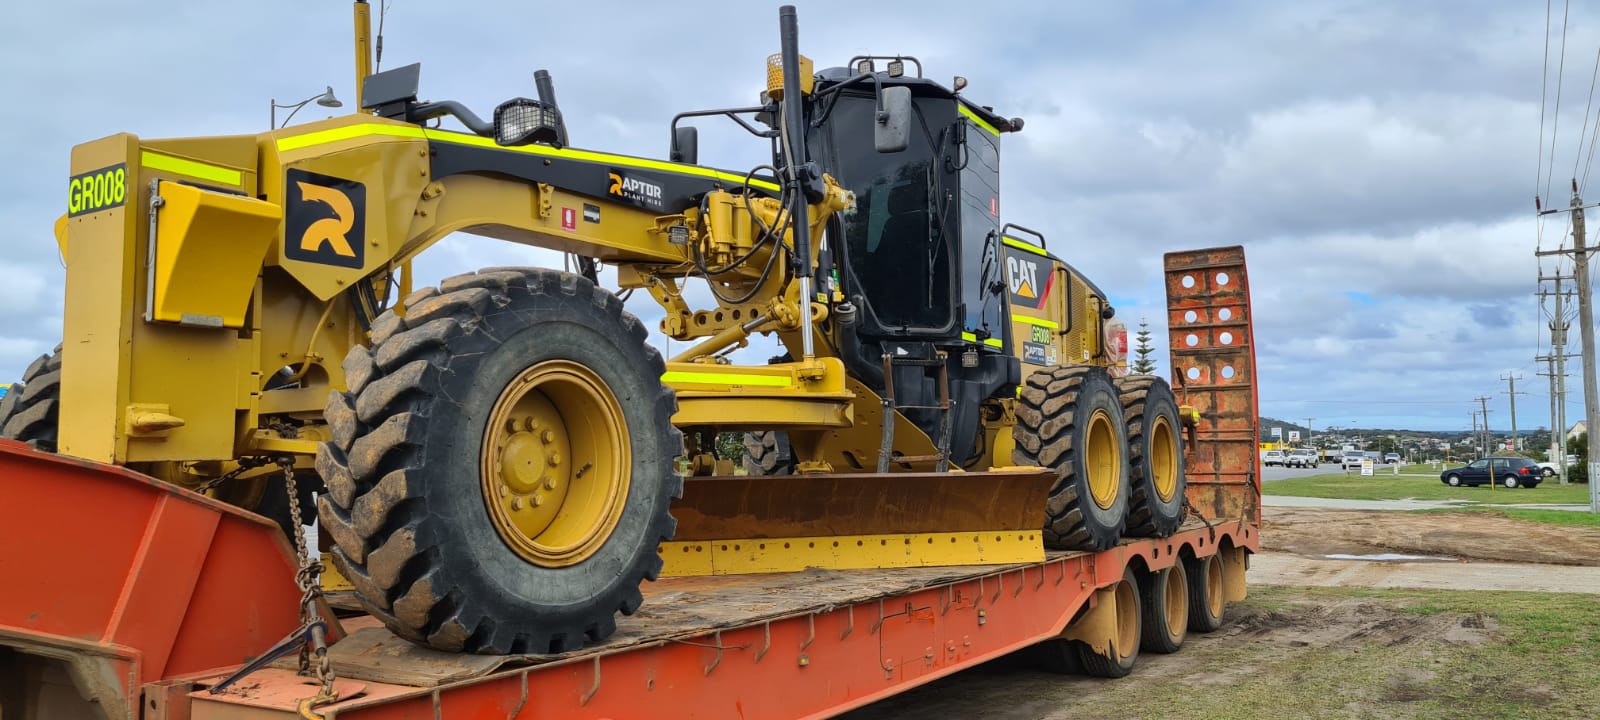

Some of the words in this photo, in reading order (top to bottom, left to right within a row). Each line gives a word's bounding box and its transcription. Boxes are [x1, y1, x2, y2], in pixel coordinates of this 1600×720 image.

[69, 168, 125, 214] GR008
[624, 191, 644, 202] PLANT
[1007, 256, 1038, 298] CAT
